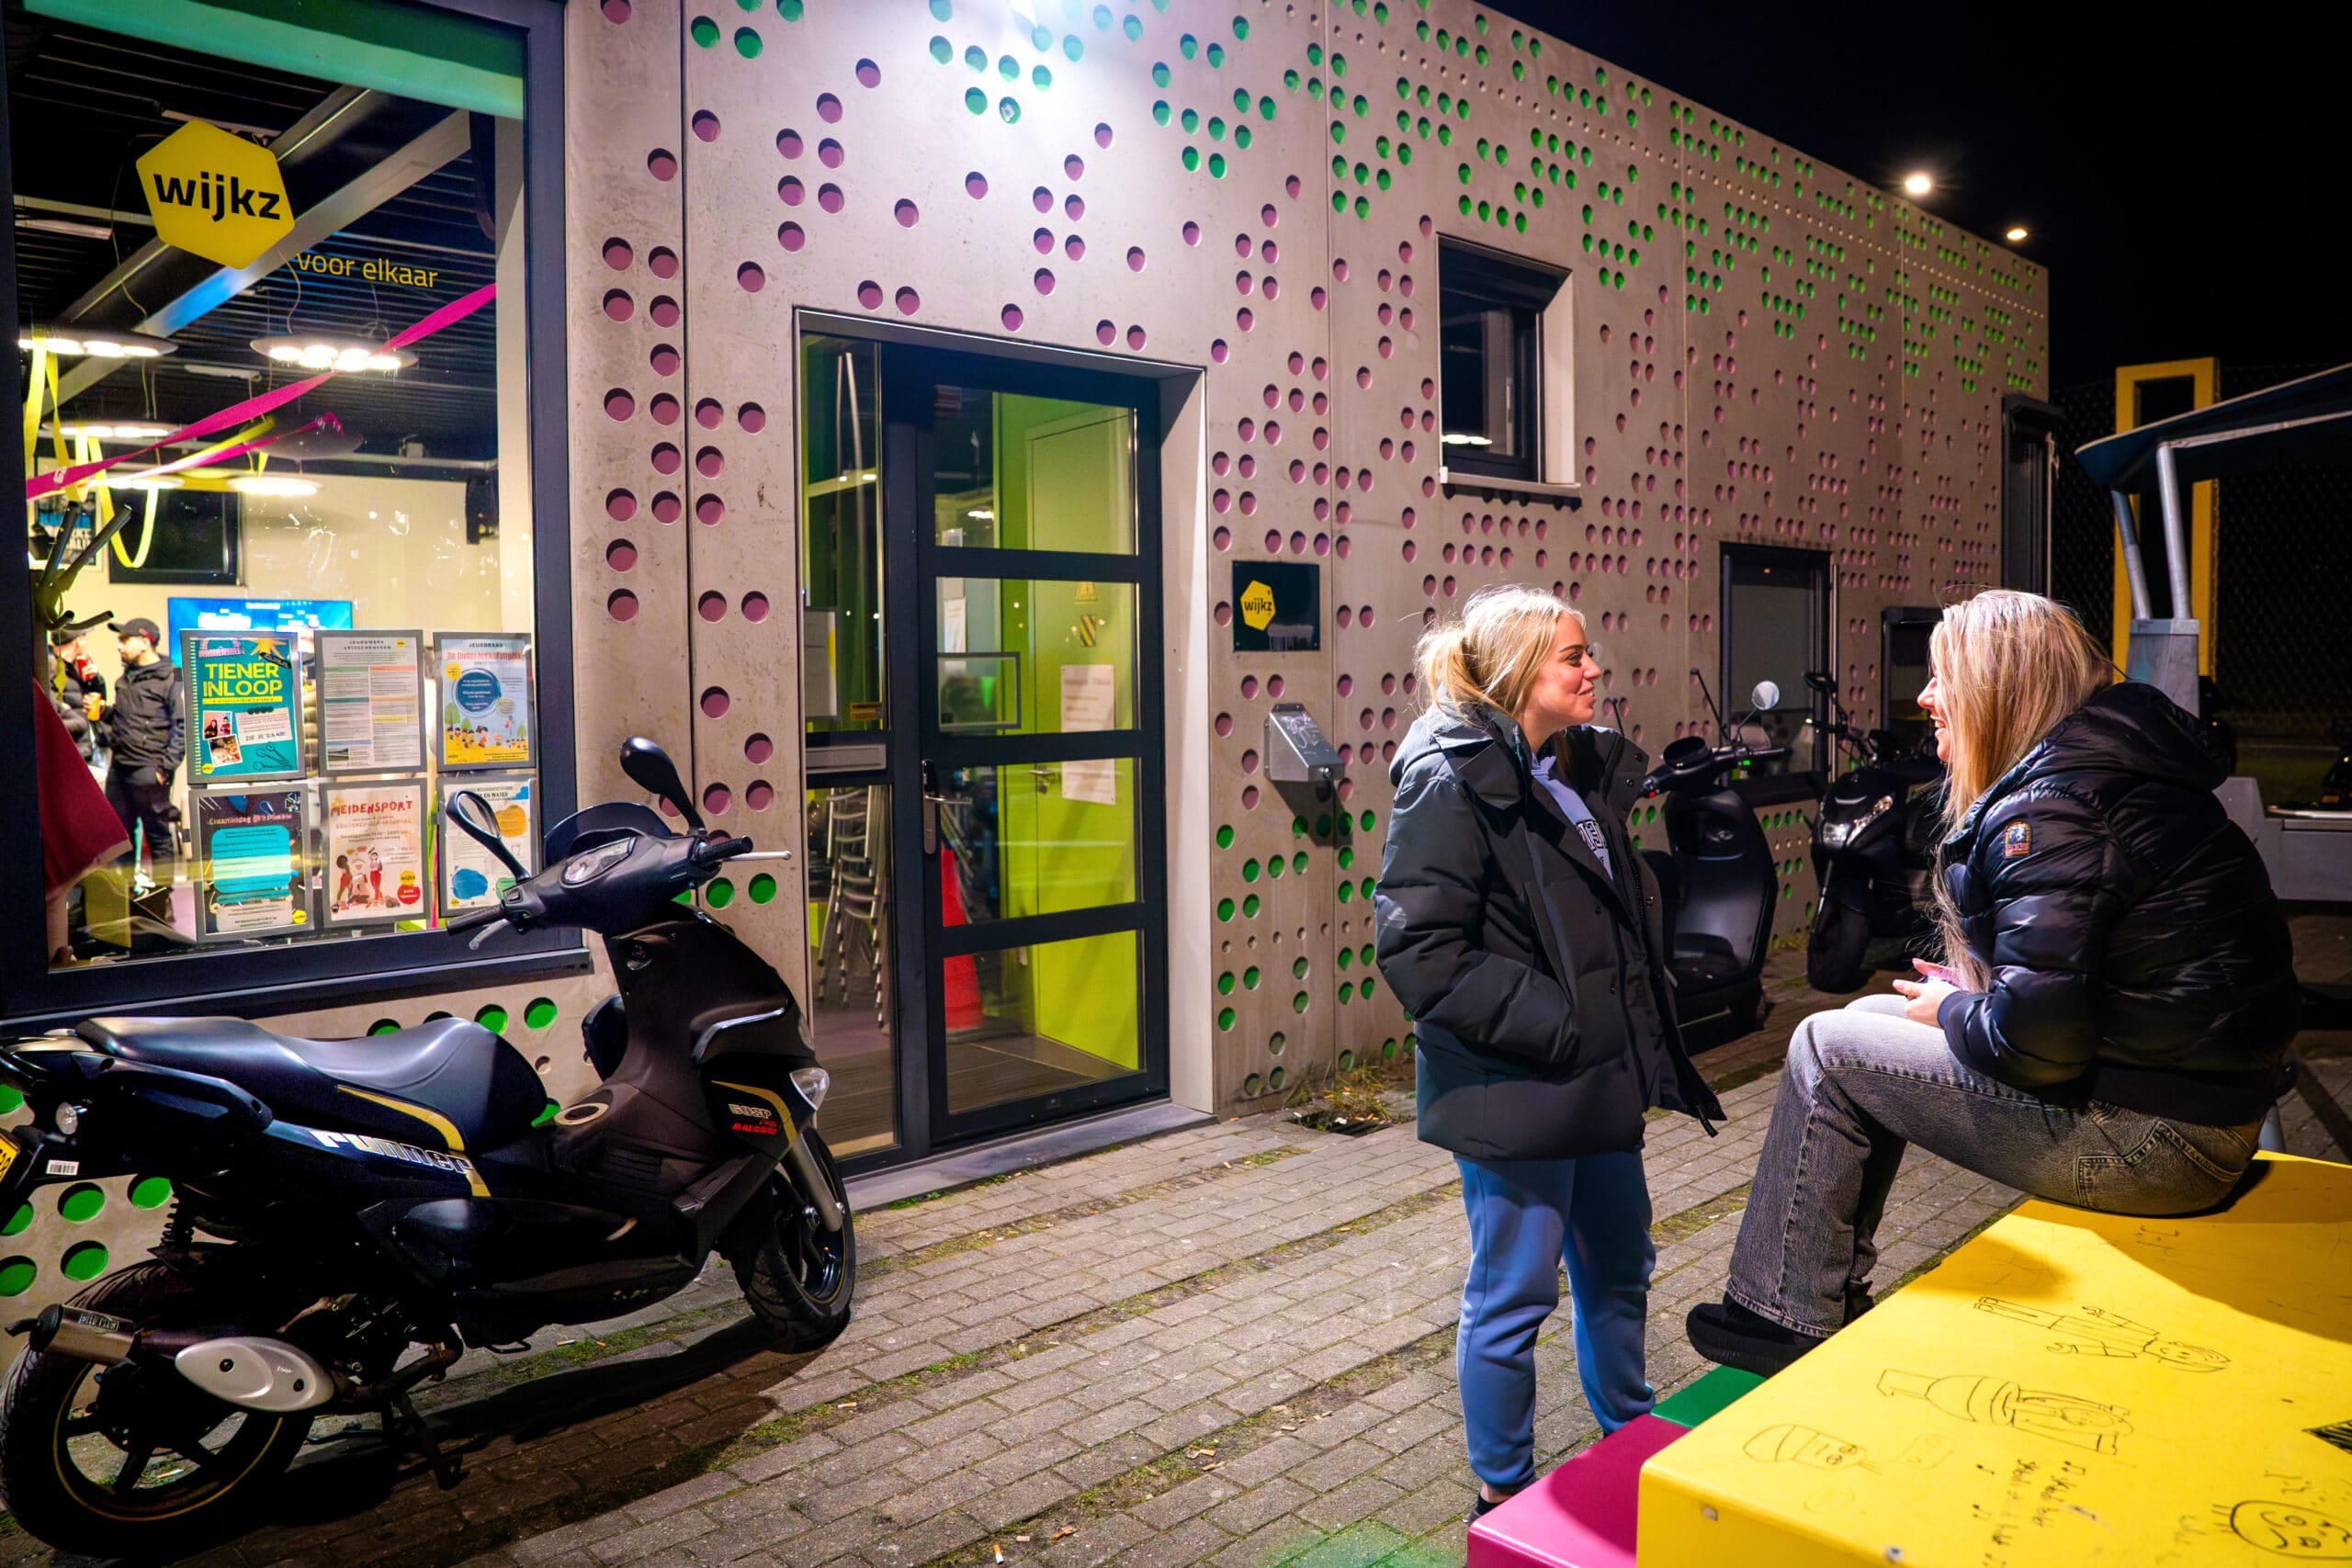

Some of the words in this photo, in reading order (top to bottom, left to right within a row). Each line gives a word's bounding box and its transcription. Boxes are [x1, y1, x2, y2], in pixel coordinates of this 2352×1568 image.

[153, 171, 281, 222] wijkz
[296, 252, 356, 276] voor
[362, 257, 438, 288] elkaar
[1243, 597, 1272, 615] wijkz
[204, 662, 280, 680] TIENER
[202, 679, 283, 698] INLOOP
[331, 800, 413, 817] MEIDENSPORT
[308, 1130, 474, 1175] runner
